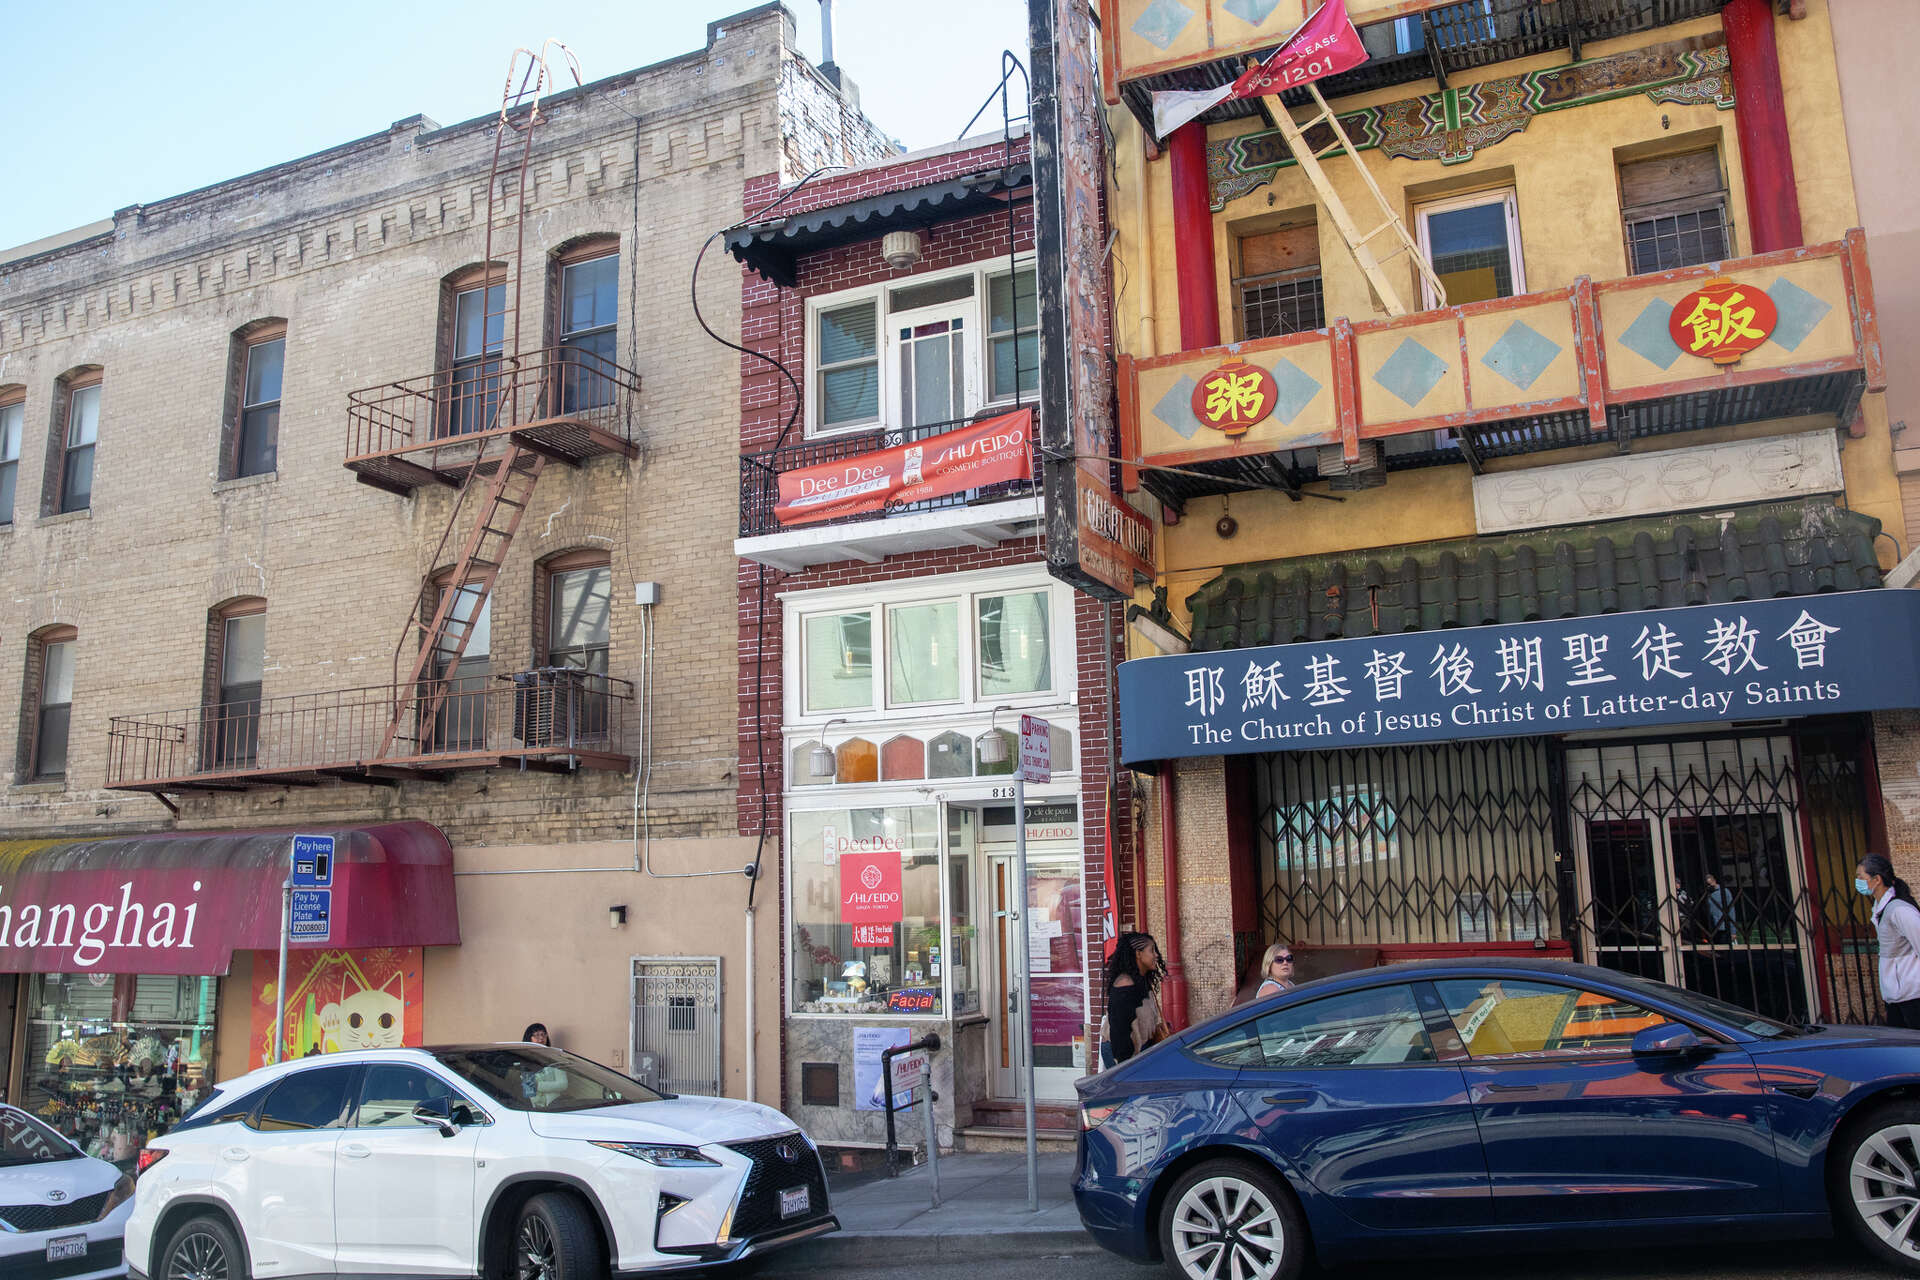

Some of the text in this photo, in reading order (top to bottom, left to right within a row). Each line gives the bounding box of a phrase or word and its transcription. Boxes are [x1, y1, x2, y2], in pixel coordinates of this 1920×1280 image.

[1681, 292, 1766, 352] 飯
[1205, 371, 1265, 421] 粥
[931, 430, 1024, 465] SHISEIDO
[936, 460, 980, 475] COSMETIC
[800, 476, 838, 496] Dee
[845, 465, 884, 485] Dee
[1188, 679, 1841, 745] The Church of Jesus Christ of Latter-day Saints
[992, 786, 1016, 798] 813
[1026, 827, 1073, 838] HISEIDO
[296, 841, 331, 853] Pay here
[838, 837, 869, 852] Dee
[873, 835, 904, 851] Dee
[294, 892, 320, 904] Pay by
[843, 892, 899, 904] SHISEIDO
[294, 902, 321, 911] License
[294, 911, 313, 920] Plate
[0, 881, 202, 966] anghai
[889, 993, 934, 1008] Facial
